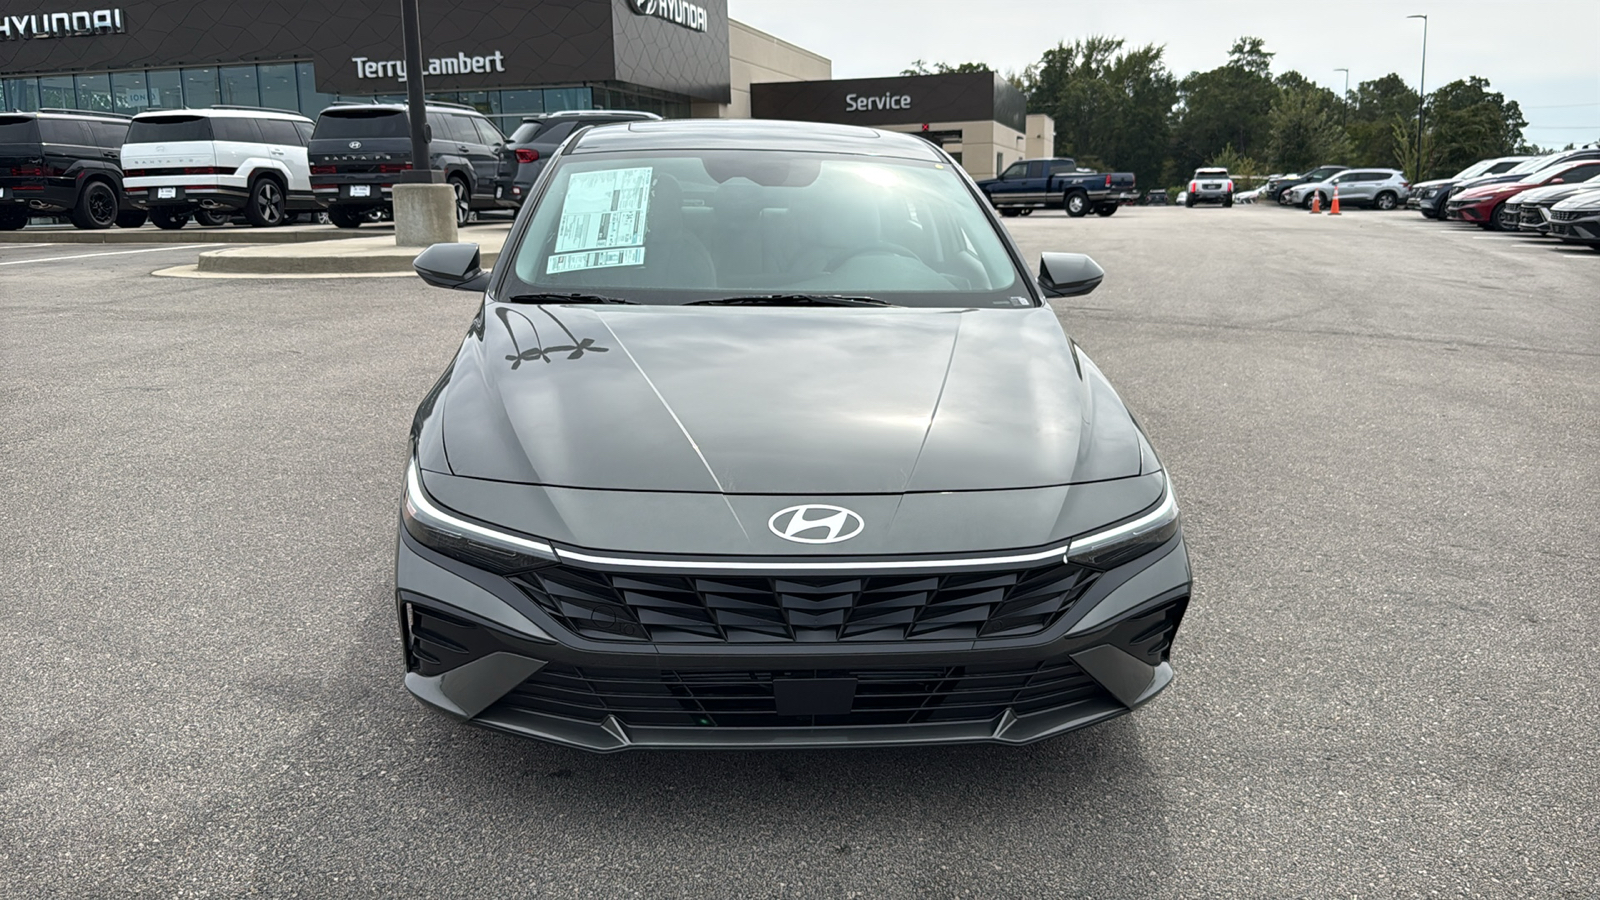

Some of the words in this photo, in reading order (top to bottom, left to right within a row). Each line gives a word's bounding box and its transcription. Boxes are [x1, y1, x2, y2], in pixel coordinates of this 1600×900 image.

[659, 0, 708, 33] HYUNDAI
[351, 56, 407, 83] Terry
[845, 91, 912, 112] Service
